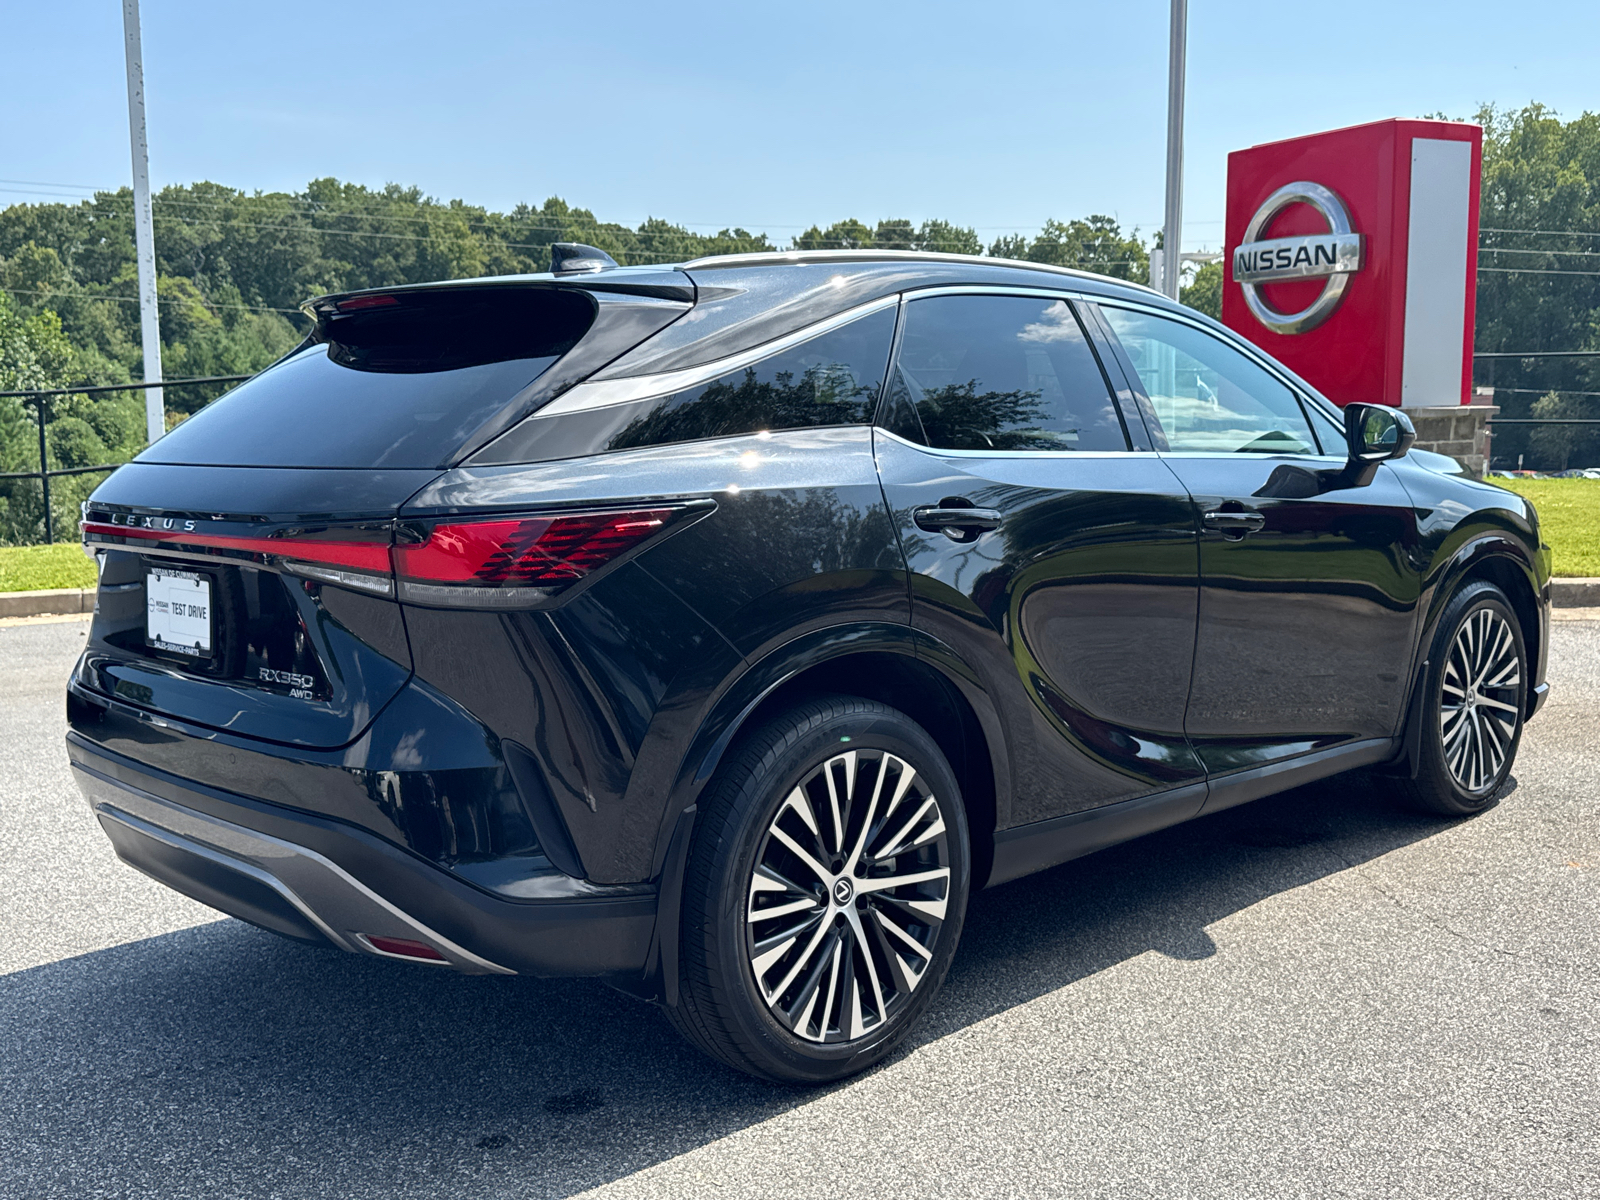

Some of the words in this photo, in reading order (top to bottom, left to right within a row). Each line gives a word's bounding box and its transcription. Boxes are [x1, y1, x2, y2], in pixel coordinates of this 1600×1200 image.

[1237, 243, 1338, 275] NISSAN
[111, 513, 196, 532] LEXUS
[171, 602, 187, 616] TEST
[188, 604, 207, 620] DRIVE
[259, 667, 314, 689] RX350
[289, 688, 313, 700] AWD
